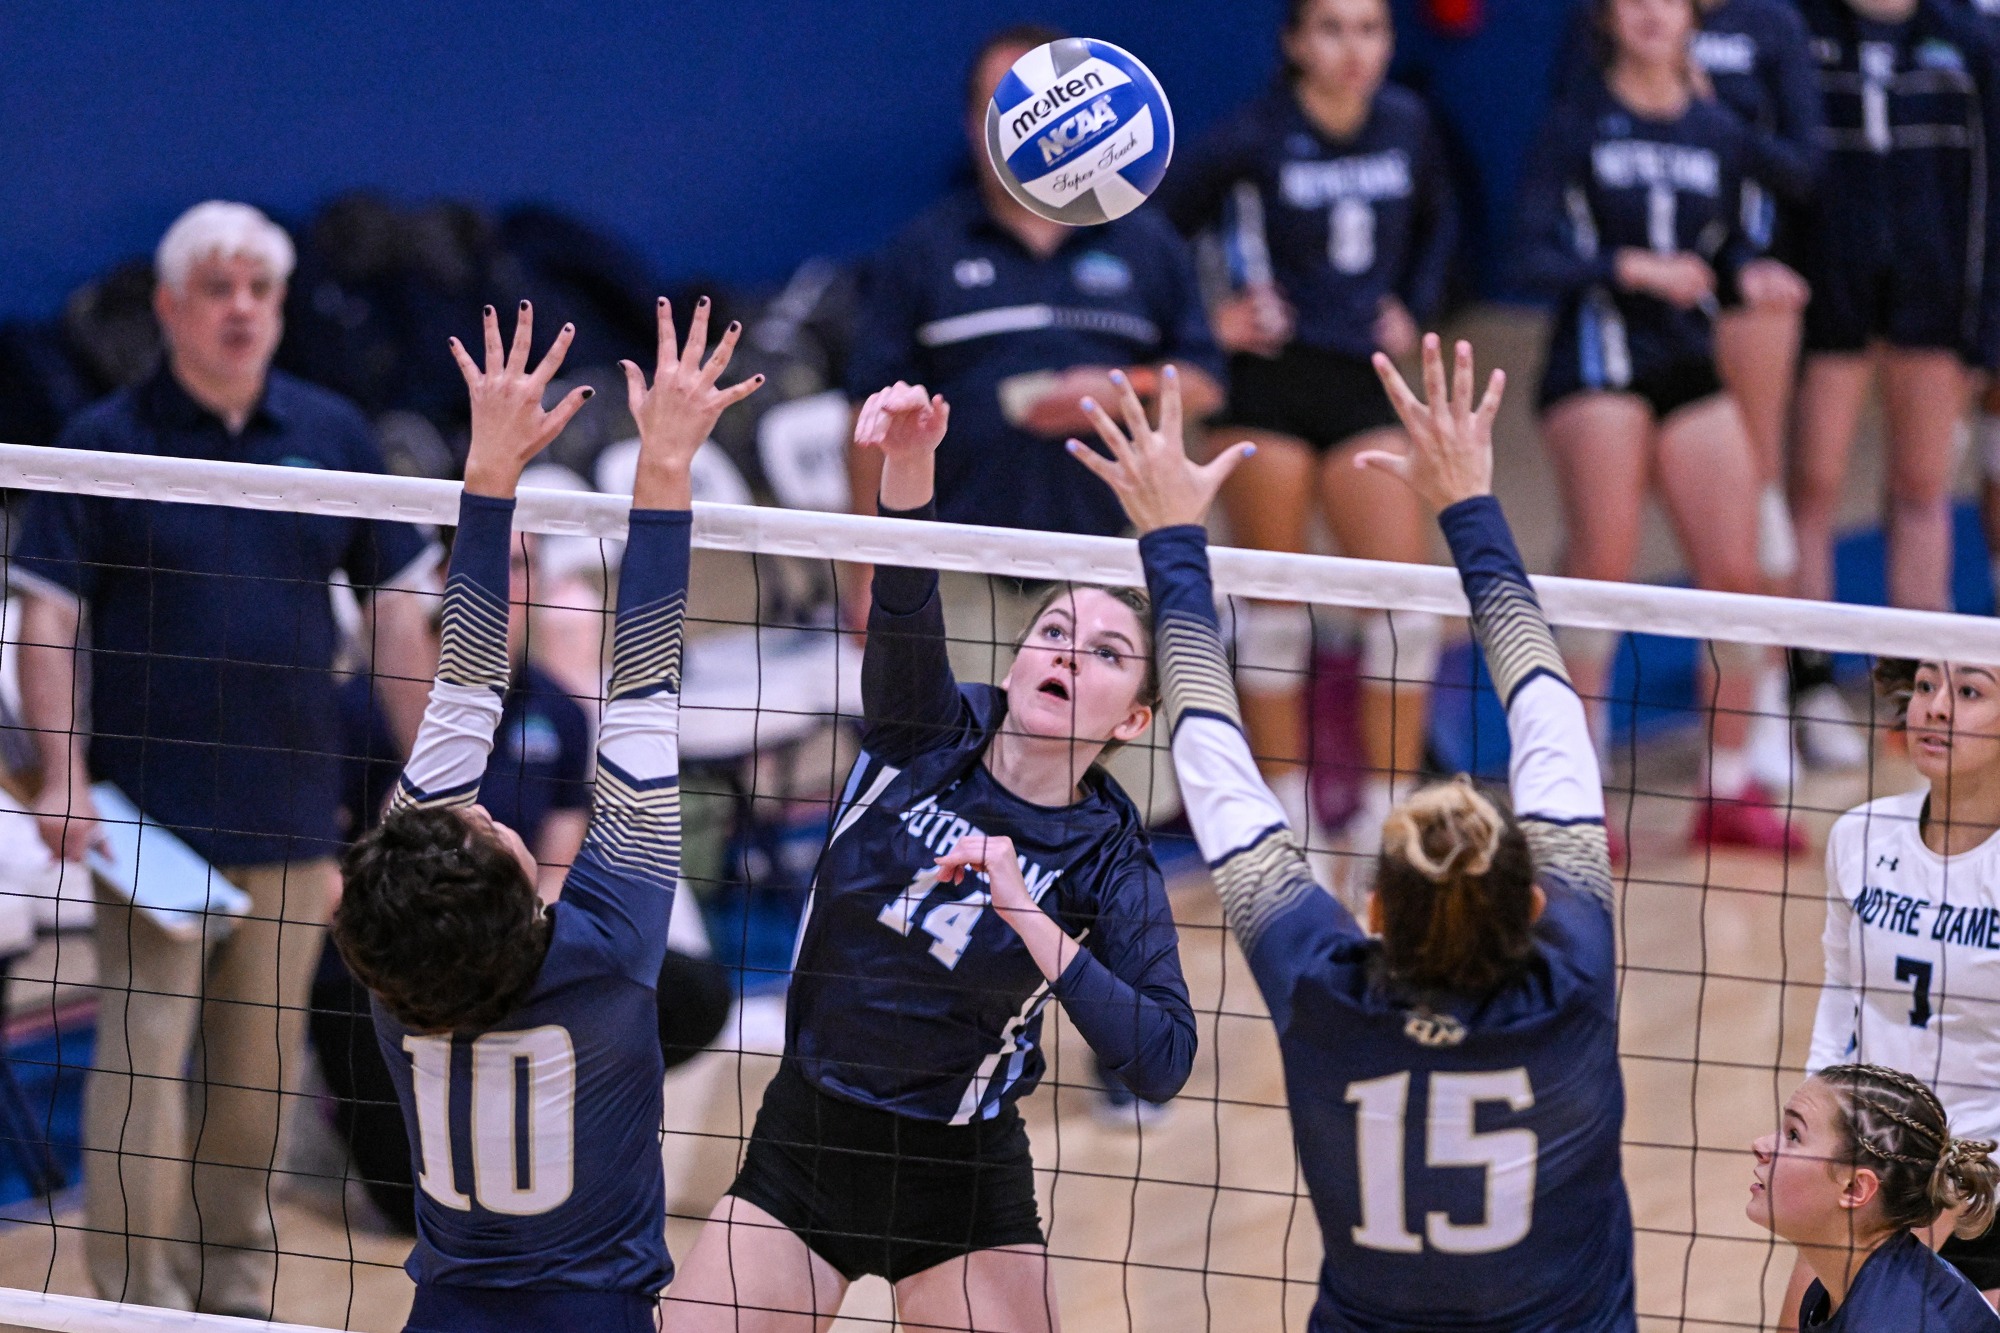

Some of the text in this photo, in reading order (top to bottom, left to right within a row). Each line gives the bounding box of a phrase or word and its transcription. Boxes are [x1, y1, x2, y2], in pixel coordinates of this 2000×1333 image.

[1012, 71, 1104, 139] molten
[1036, 96, 1119, 166] NCAA
[1053, 131, 1138, 193] Super Touch
[877, 865, 992, 971] 14
[1852, 885, 2000, 949] NOTRE DAME
[1895, 954, 1934, 1030] 7
[402, 1024, 577, 1216] 10
[1343, 1065, 1539, 1255] 15
